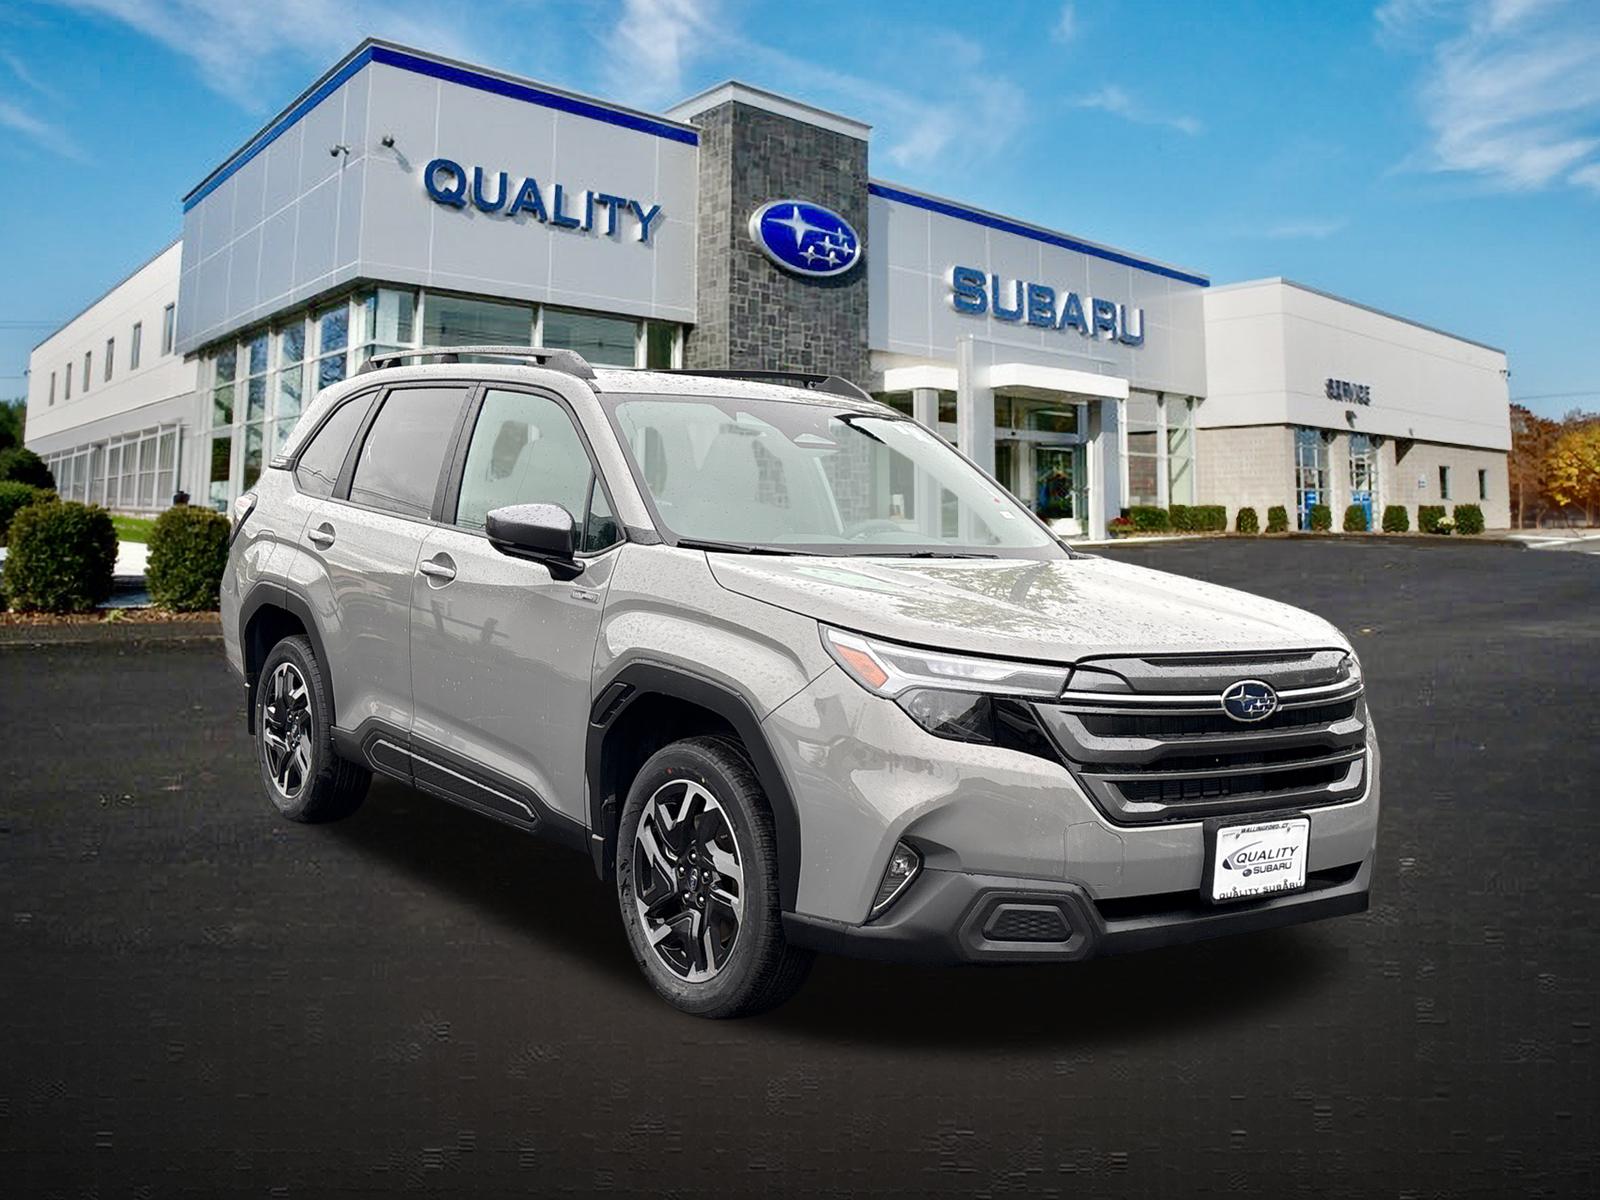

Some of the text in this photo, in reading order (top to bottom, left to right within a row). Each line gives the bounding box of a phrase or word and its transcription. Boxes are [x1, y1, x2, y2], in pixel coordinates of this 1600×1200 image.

[424, 158, 661, 242] QUALITY
[951, 265, 1144, 346] SUBARU
[1325, 378, 1371, 407] SERVICE
[1236, 846, 1299, 863] QUALITY
[1253, 862, 1292, 874] SUBARU
